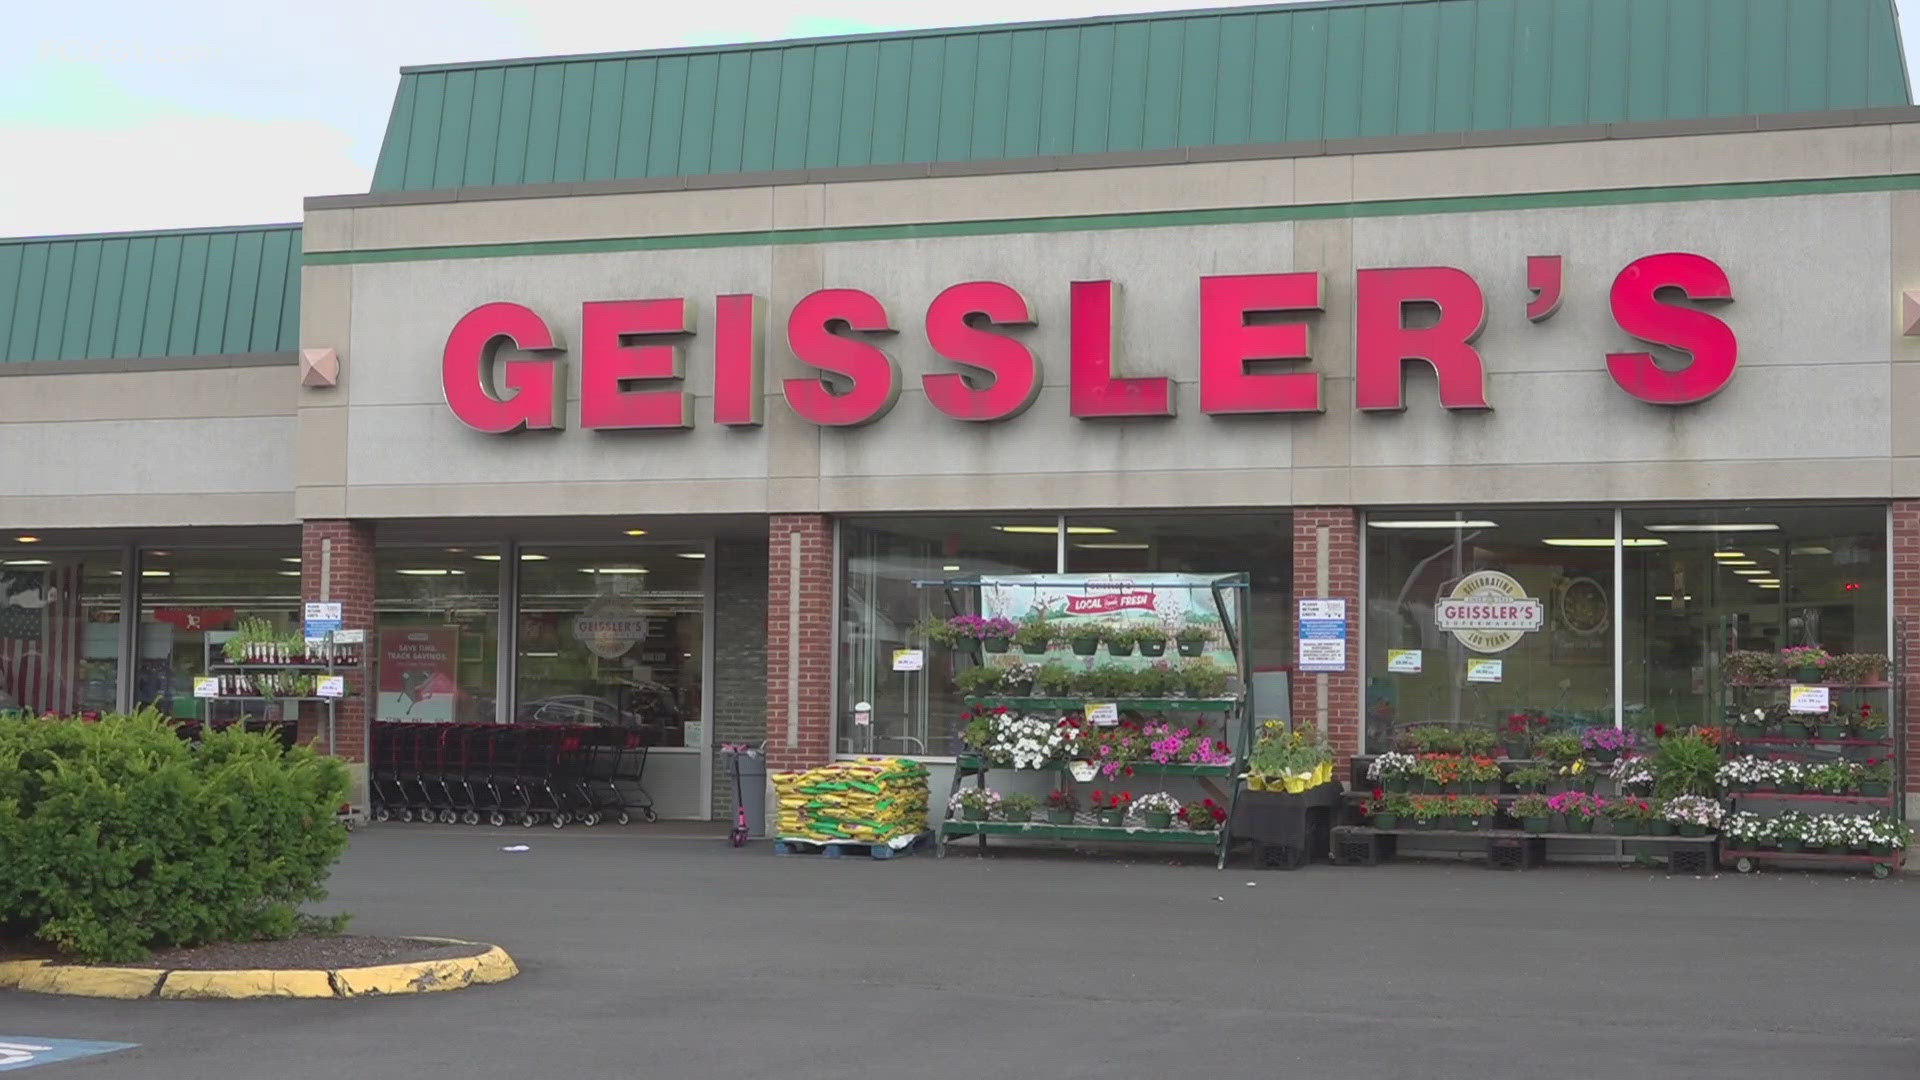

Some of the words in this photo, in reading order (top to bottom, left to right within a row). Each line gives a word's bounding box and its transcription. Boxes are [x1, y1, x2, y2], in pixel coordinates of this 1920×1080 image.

[441, 252, 1738, 434] GEISSLER'S
[1463, 577, 1513, 595] CELEBRATING
[1075, 598, 1102, 610] LOCAL
[1120, 594, 1148, 606] FRESH
[1445, 606, 1533, 619] GEISSLER'S
[579, 621, 642, 632] GEISSLER'S
[1485, 632, 1510, 647] YEARS
